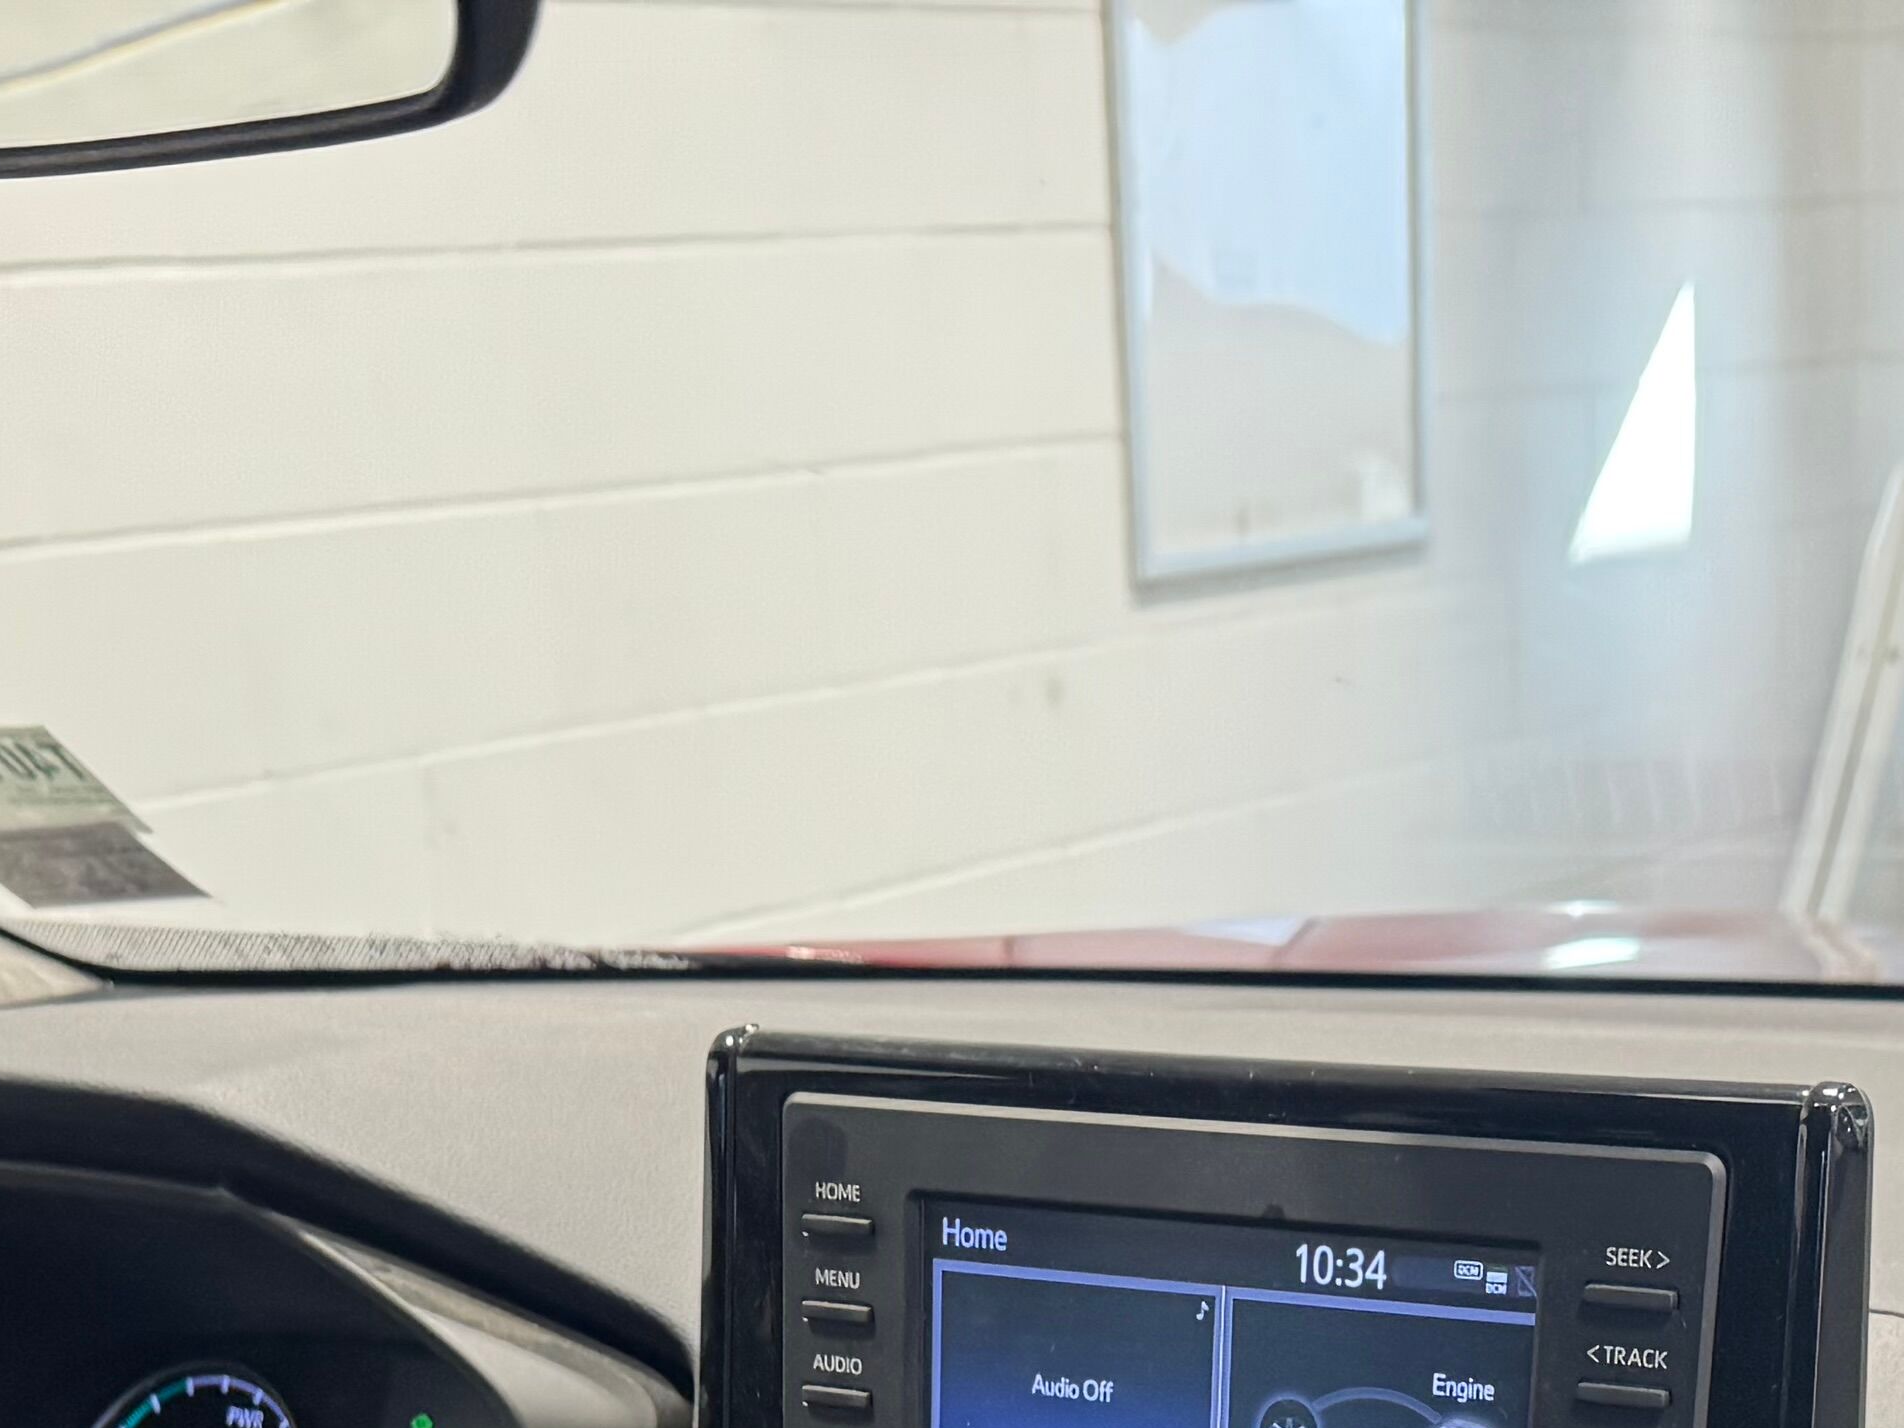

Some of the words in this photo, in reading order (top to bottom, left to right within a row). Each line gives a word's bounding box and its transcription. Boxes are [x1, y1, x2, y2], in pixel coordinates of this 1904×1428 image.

[815, 1181, 861, 1202] HOME
[942, 1216, 1008, 1251] Home
[1295, 1243, 1388, 1290] 10:34
[1605, 1246, 1652, 1268] SEEK
[815, 1267, 861, 1289] MENU
[813, 1354, 863, 1375] AUDIO
[1603, 1345, 1668, 1370] TRACK
[1031, 1373, 1080, 1400] Audio
[1082, 1378, 1114, 1403] Off
[1431, 1372, 1495, 1403] Engine
